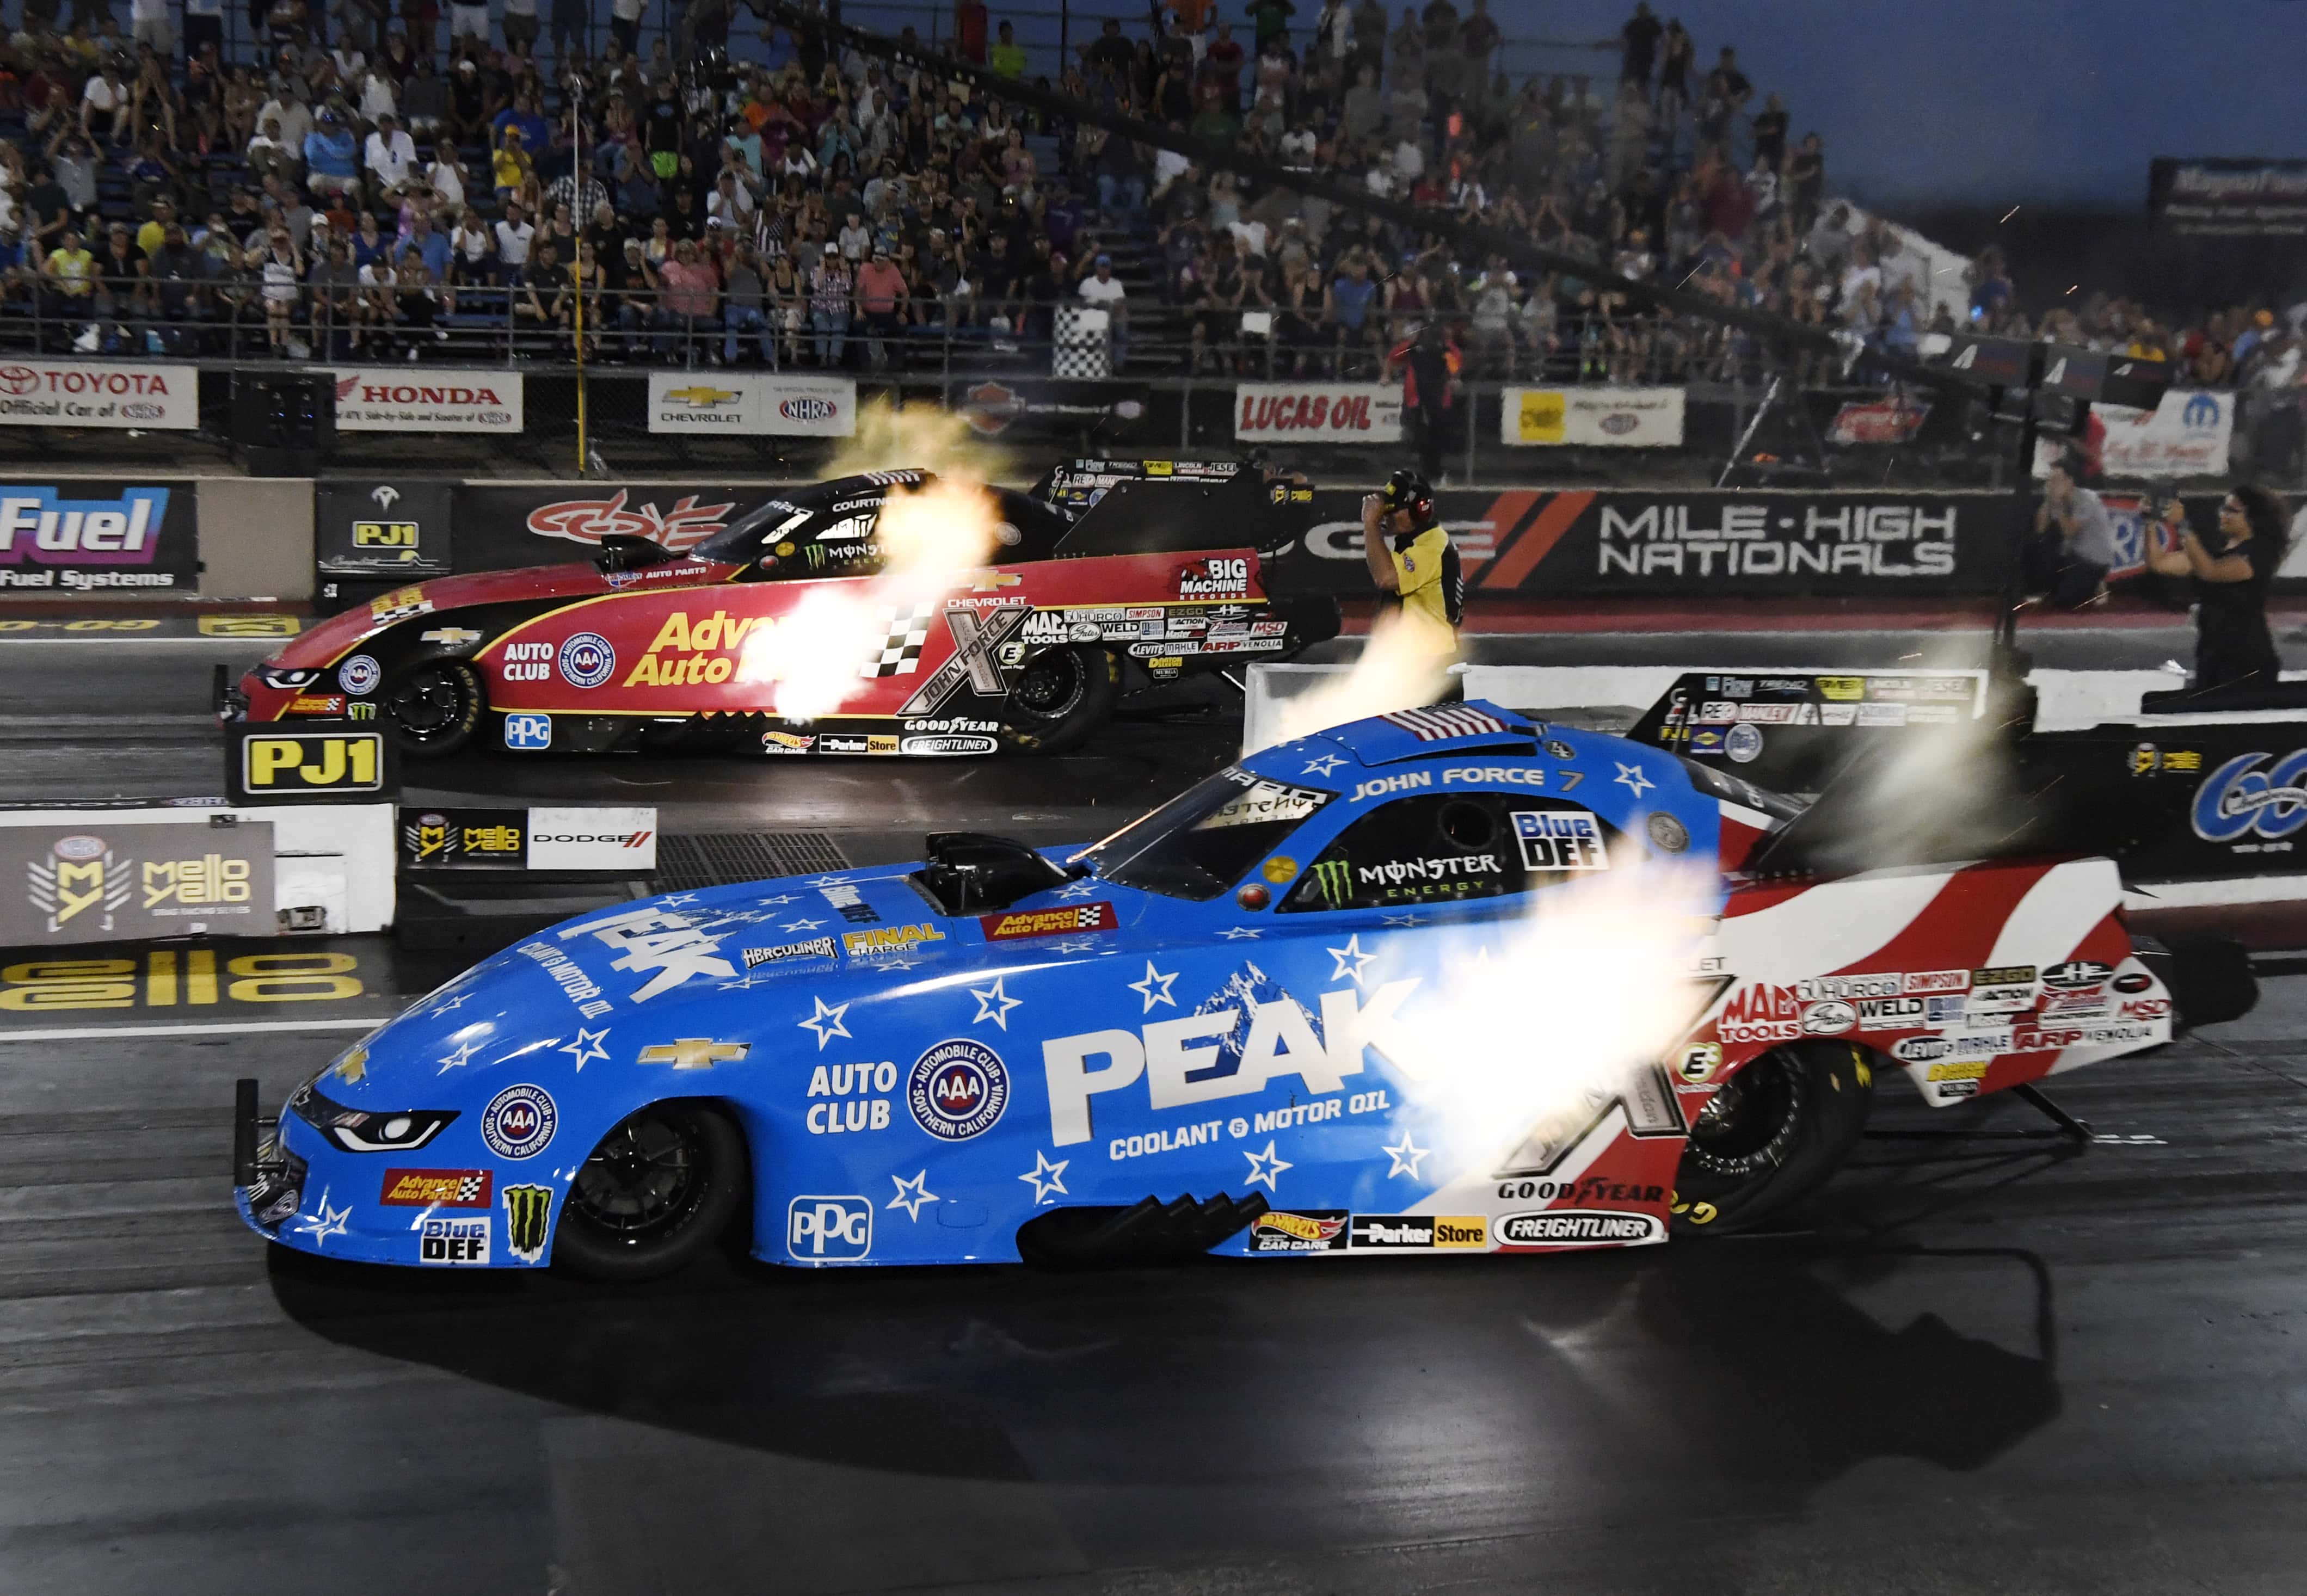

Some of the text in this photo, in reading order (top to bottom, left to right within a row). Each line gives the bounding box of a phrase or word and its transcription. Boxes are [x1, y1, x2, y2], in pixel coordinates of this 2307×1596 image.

[45, 371, 169, 395] TOYOTA
[361, 385, 502, 405] HONDA
[661, 412, 743, 423] CHEVROLET
[788, 400, 830, 419] NHRA
[1239, 394, 1371, 431] LUCAS OIL
[0, 497, 152, 551] Fuel
[356, 524, 415, 545] PJ1
[1598, 541, 1956, 576] NATIONALS
[646, 571, 673, 579] AUTO
[675, 566, 707, 576] PARTS
[1209, 559, 1247, 579] BIG
[0, 570, 174, 590] Fuel Systems
[1180, 579, 1247, 593] MACHINE
[947, 596, 1026, 608] CHEVROLET
[1021, 611, 1068, 636] MAC
[1079, 612, 1122, 621] HURCO
[1128, 608, 1162, 619] SIMPSON
[1100, 622, 1140, 633] WELD
[1253, 621, 1285, 633] MSD
[564, 635, 598, 656] AUTOMOBILE
[1021, 634, 1068, 644] TOOLS
[1131, 642, 1165, 655] CLEVITE
[1166, 643, 1196, 651] MAHLE
[1201, 639, 1282, 651] ARP VENOLIA
[504, 643, 555, 661] AUTO
[575, 652, 599, 665] AAA
[923, 613, 1007, 707] JOHN FORCE
[503, 663, 551, 681] CLUB
[623, 652, 733, 687] Auto
[508, 717, 549, 745] PPG
[903, 717, 999, 734] GOODYEAR
[829, 738, 896, 751] Parker Store
[911, 739, 988, 751] FREIGHTLINER
[251, 740, 377, 785] PJ1
[1349, 767, 1585, 802] JOHN FORCE 7
[1515, 814, 1596, 837] Blue
[533, 834, 635, 843] DODGE
[1522, 838, 1599, 867] DEF
[1358, 854, 1502, 885] MONSTER
[1387, 880, 1484, 897] ENERGY
[993, 920, 1073, 935] Auto Parts
[999, 910, 1074, 926] Advance
[842, 923, 946, 949] FINAL
[741, 936, 839, 969] HERCULINER
[847, 943, 917, 957] CHARGE
[547, 962, 601, 1003] MOTOR
[1722, 982, 1800, 1022] MAC
[1859, 997, 1923, 1018] WELD
[1720, 1023, 1802, 1043] TOOLS
[916, 1044, 1001, 1083] AUTOMOBILE CLUB
[1042, 977, 1429, 1147] PEAK
[806, 1061, 899, 1098] AUTO
[936, 1075, 981, 1101] AAA
[490, 1088, 552, 1116] AUTOMOBILE CLUB
[913, 1083, 1005, 1136] SOUTHERN CALIFORNIA
[502, 1110, 534, 1129] AAA
[806, 1099, 891, 1135] CLUB
[1109, 1120, 1223, 1161] COOLANT
[1254, 1098, 1342, 1134] MOTOR
[1349, 1089, 1391, 1115] OIL
[485, 1116, 553, 1156] SOUTHERN CALIFORNIA
[396, 1175, 457, 1190] Advance
[1498, 1178, 1664, 1204] GOODYEAR
[387, 1188, 453, 1200] Auto Parts
[423, 1221, 485, 1237] Blue
[792, 1203, 867, 1254] PPG
[1272, 1214, 1321, 1239] WHEELS
[1368, 1222, 1484, 1243] Parker Store
[1509, 1217, 1647, 1237] FREIGHTLINER
[422, 1237, 484, 1261] DEF
[1258, 1240, 1331, 1250] CAR CARE
